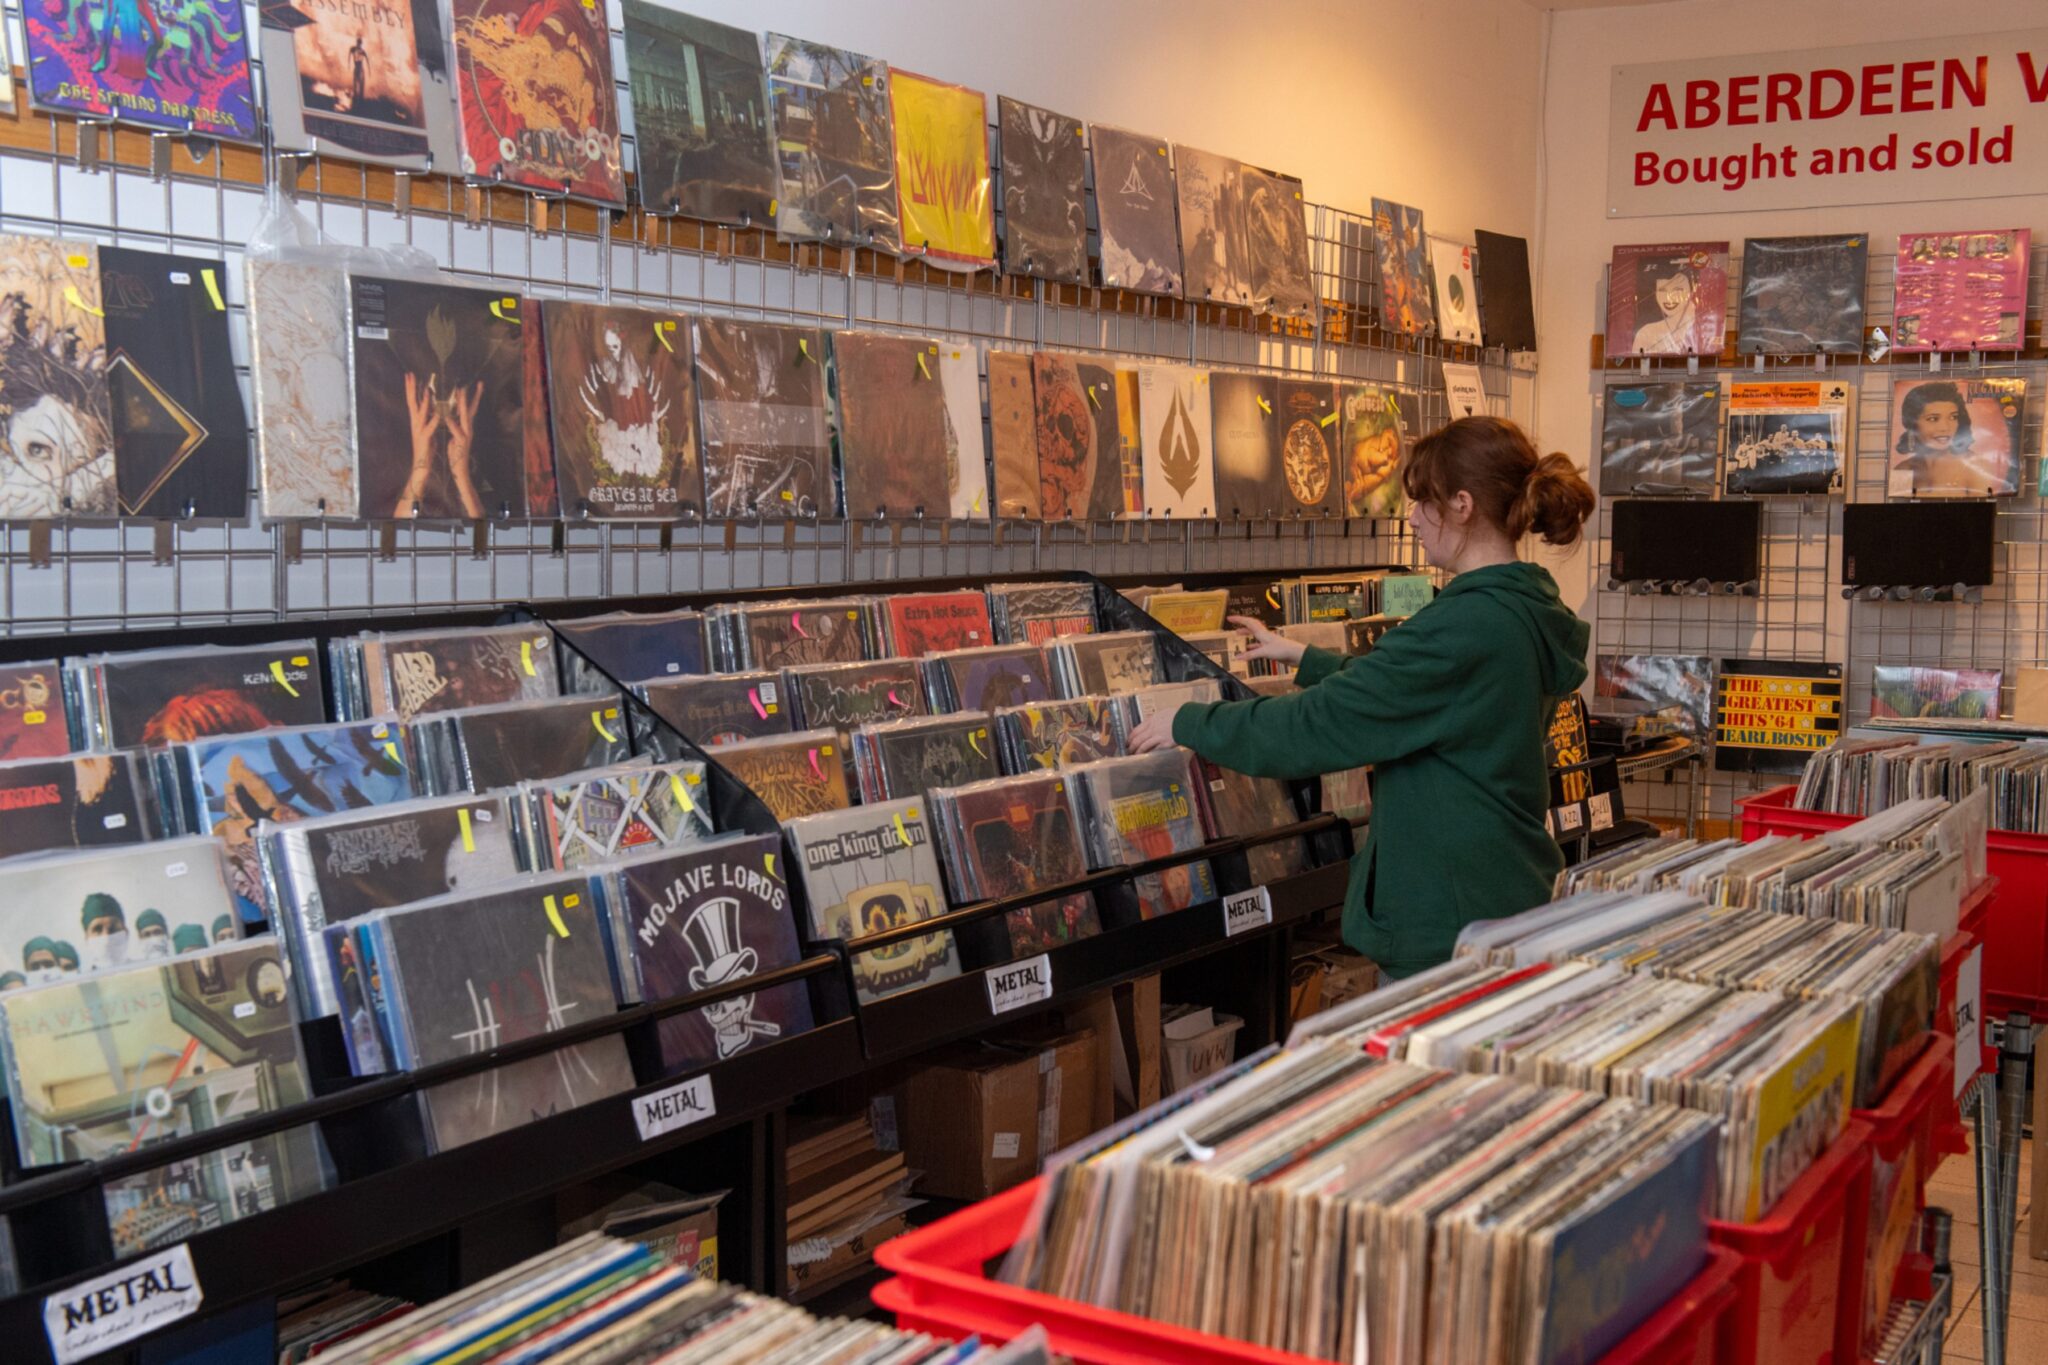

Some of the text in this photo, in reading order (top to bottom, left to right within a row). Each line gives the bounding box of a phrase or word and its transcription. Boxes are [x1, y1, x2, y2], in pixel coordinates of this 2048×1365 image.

[58, 82, 92, 101] THE
[1637, 55, 1988, 132] ABERDEEN
[1633, 125, 2014, 191] Bought and sold
[588, 486, 678, 503] GRAVES AT SEA
[904, 603, 978, 621] Extra Hot Sauce
[1025, 619, 1055, 647] IRON
[242, 669, 308, 686] KEN ode
[1729, 679, 1763, 693] THE
[1727, 695, 1817, 713] GREATEST
[1727, 712, 1795, 729] HITS '64
[1725, 729, 1770, 745] EARL
[807, 842, 841, 865] one
[841, 831, 881, 858] king
[638, 862, 786, 947] MOJAVE LORDS
[1227, 895, 1266, 920] METAL
[992, 964, 1047, 997] METAL
[644, 1086, 708, 1127] METAL
[60, 1260, 193, 1335] METAL
